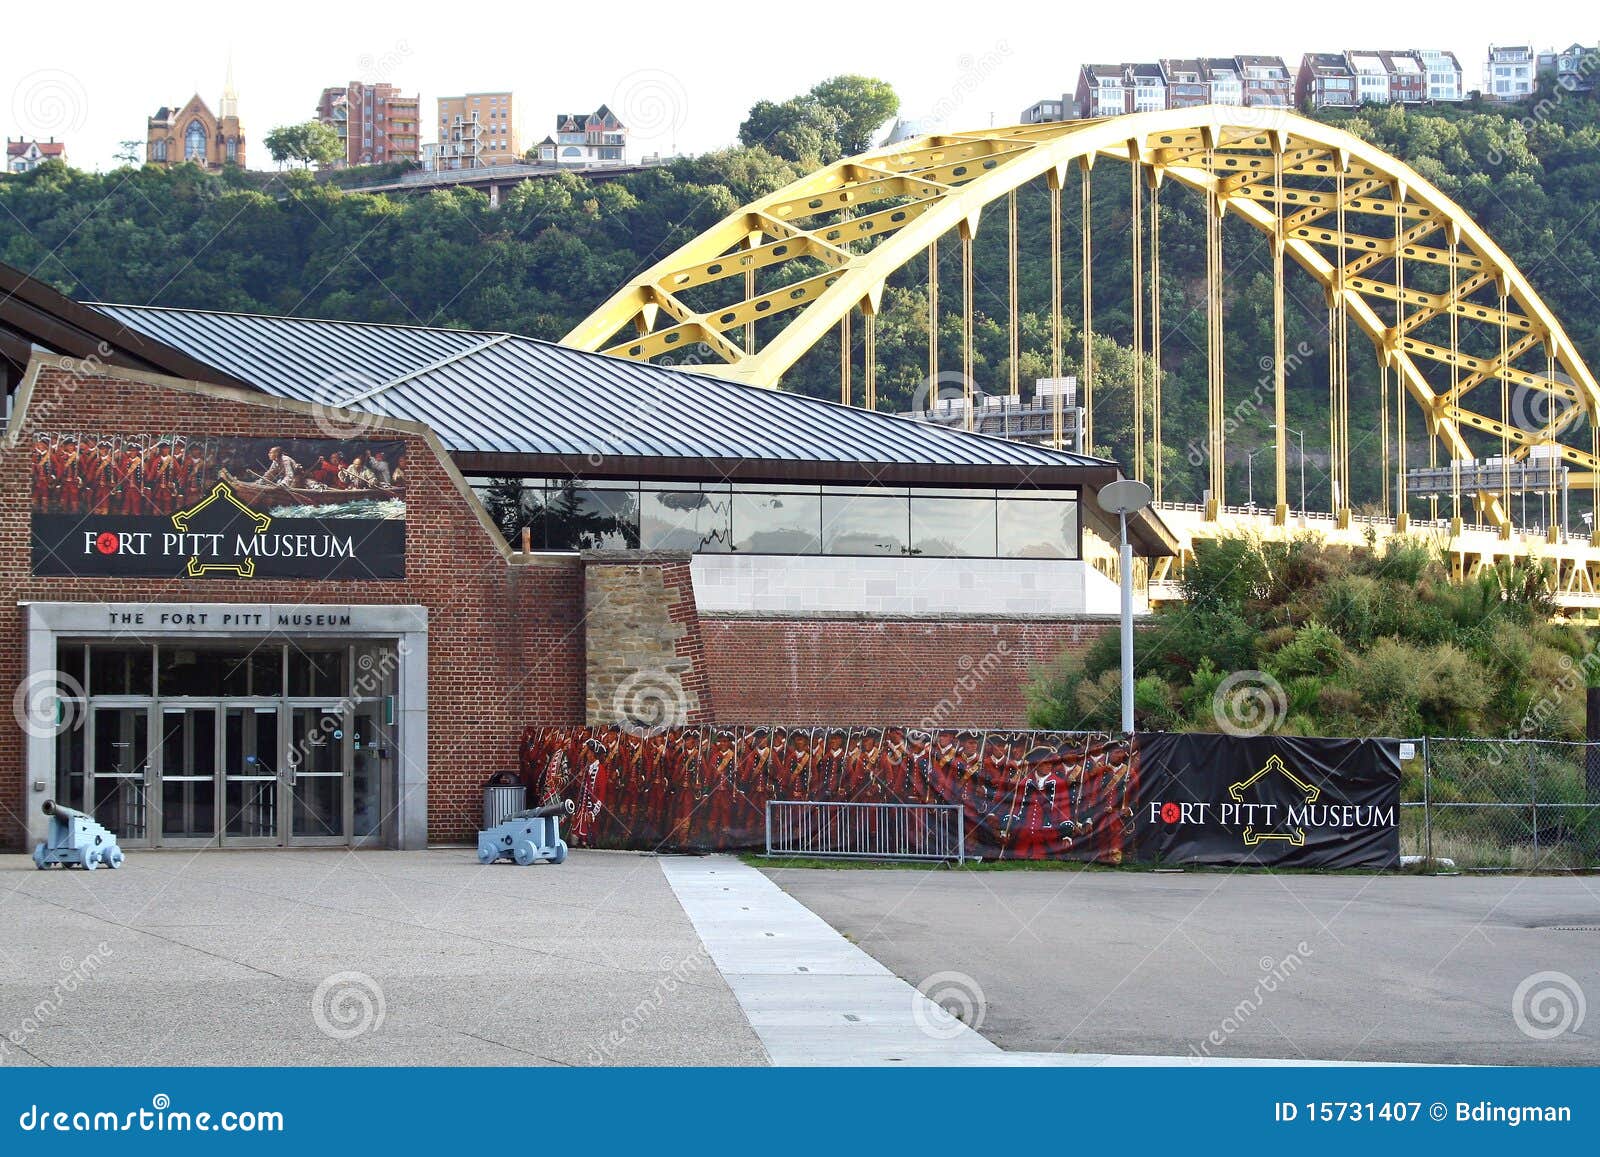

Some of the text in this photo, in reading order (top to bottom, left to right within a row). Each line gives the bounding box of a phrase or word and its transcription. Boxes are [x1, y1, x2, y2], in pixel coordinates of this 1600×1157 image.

[84, 531, 356, 558] FORT PITT MUSEUM
[110, 613, 351, 626] THE FORT PITT MUSEUM
[1149, 801, 1398, 827] FORT PITT MUSEUM
